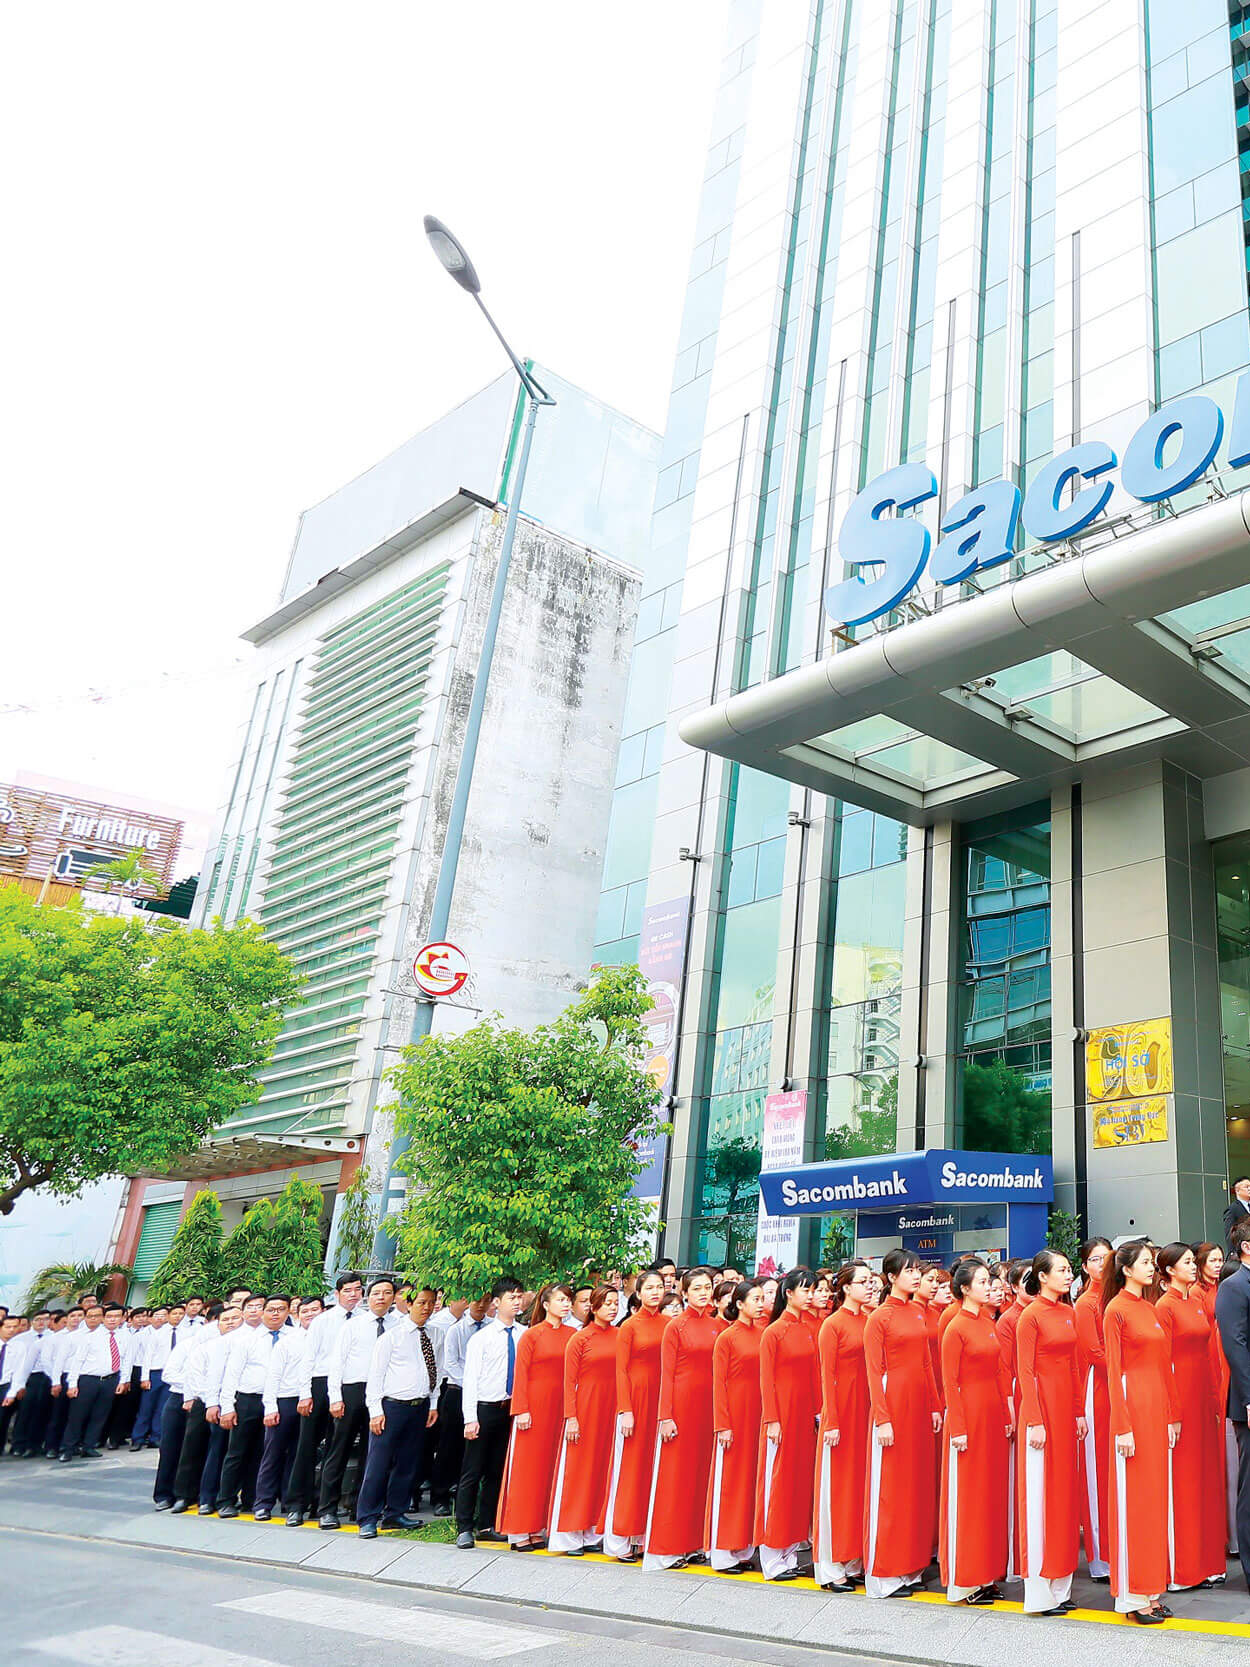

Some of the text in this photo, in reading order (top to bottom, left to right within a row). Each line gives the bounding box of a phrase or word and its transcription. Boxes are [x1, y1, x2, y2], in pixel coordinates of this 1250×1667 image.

[60, 808, 161, 850] Furniture
[781, 1170, 908, 1206] Sacombank
[941, 1161, 1044, 1189] Sacombank
[898, 1216, 956, 1229] Sacombank
[917, 1238, 937, 1249] ATM
